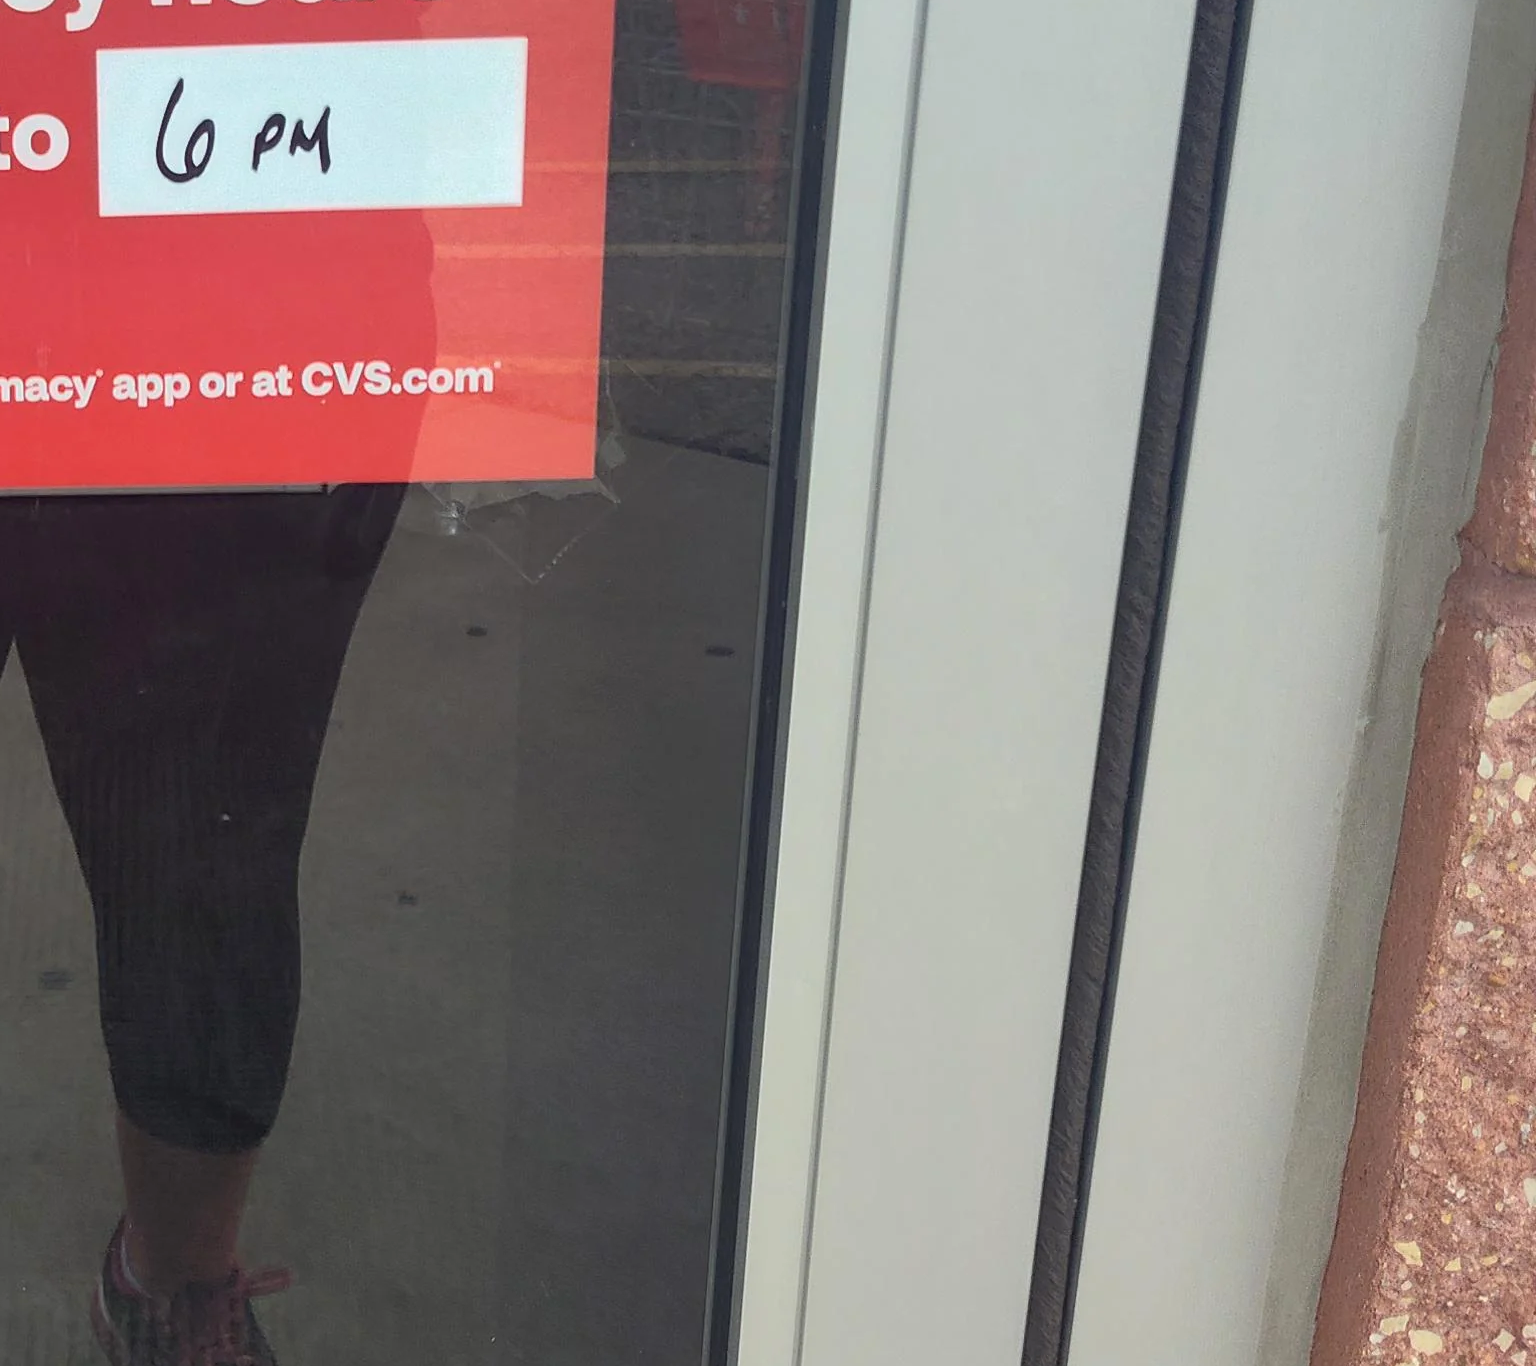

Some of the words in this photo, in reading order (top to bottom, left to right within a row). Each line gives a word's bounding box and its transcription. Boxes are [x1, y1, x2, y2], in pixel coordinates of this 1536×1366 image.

[155, 78, 215, 183] 6
[252, 106, 331, 174] PM
[112, 372, 191, 408] app
[199, 371, 244, 399] or
[251, 365, 293, 397] at
